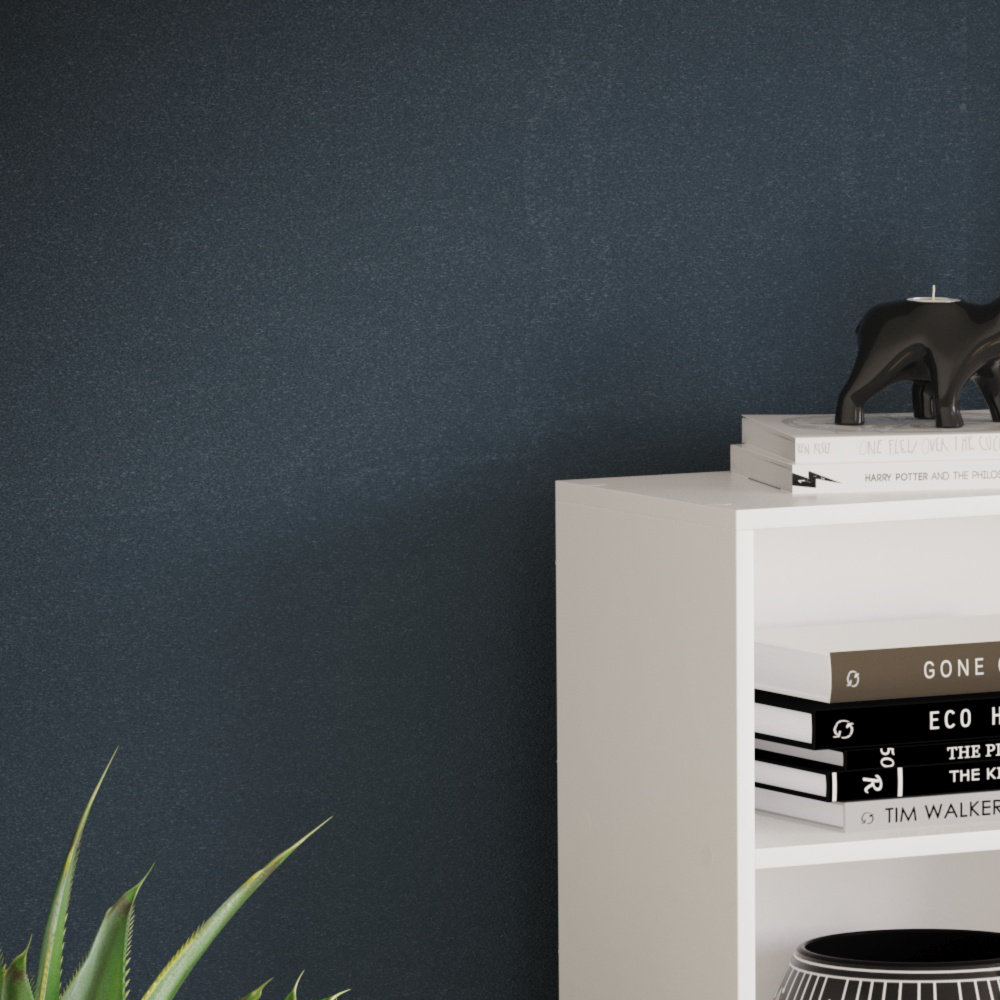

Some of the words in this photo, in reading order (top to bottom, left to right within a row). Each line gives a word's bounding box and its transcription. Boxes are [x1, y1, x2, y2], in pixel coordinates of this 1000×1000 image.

[865, 472, 891, 482] HARRY
[895, 472, 928, 482] POTTER
[931, 471, 950, 481] AND
[953, 470, 969, 481] THE
[923, 657, 985, 680] GONE
[928, 708, 972, 731] ECO
[879, 747, 896, 769] 50
[946, 744, 981, 761] THE
[948, 768, 981, 784] THE
[885, 806, 917, 823] TIM
